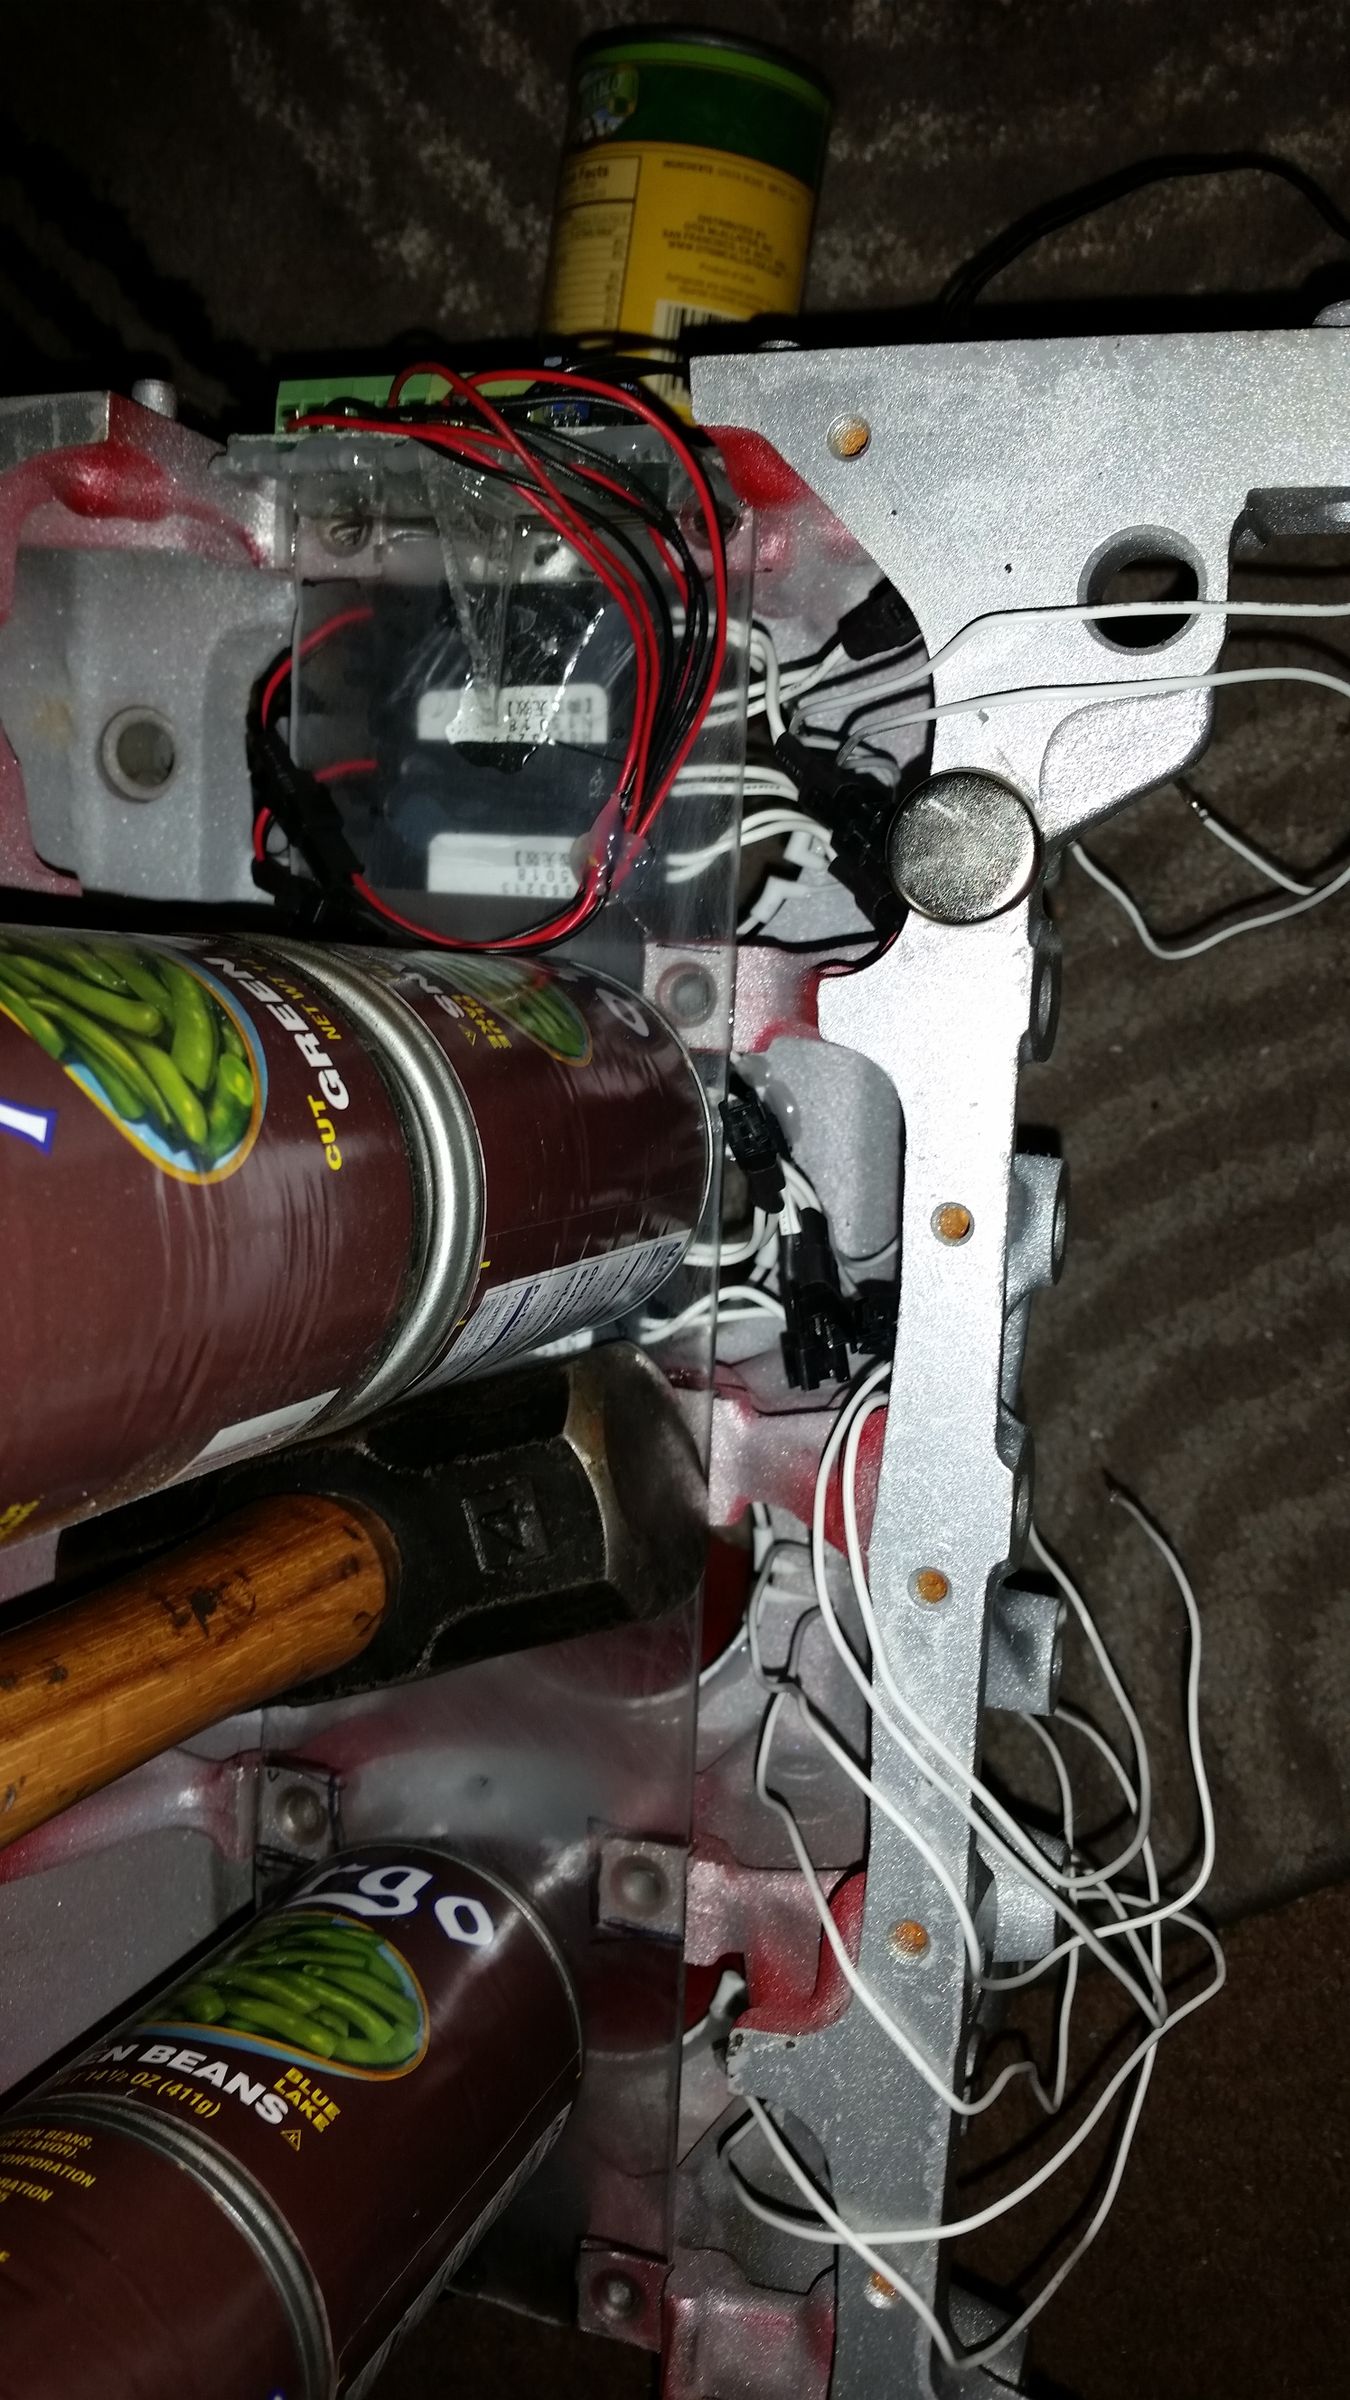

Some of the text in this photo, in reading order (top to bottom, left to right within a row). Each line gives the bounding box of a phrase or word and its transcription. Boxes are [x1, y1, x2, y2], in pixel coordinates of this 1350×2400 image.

[267, 975, 305, 1001] WT
[203, 957, 349, 1110] GREEN
[300, 1003, 342, 1040] NET
[450, 994, 502, 1050] LAKE
[461, 993, 513, 1049] BLUE
[306, 1094, 343, 1171] CUT
[501, 1283, 542, 1342] Protein
[130, 2071, 162, 2089] OZ
[157, 2080, 221, 2119] (411g)
[138, 2044, 289, 2125] BEANS
[273, 2077, 331, 2133] LAKE
[284, 2066, 341, 2122] BLUE
[44, 2129, 93, 2150] BEANS,
